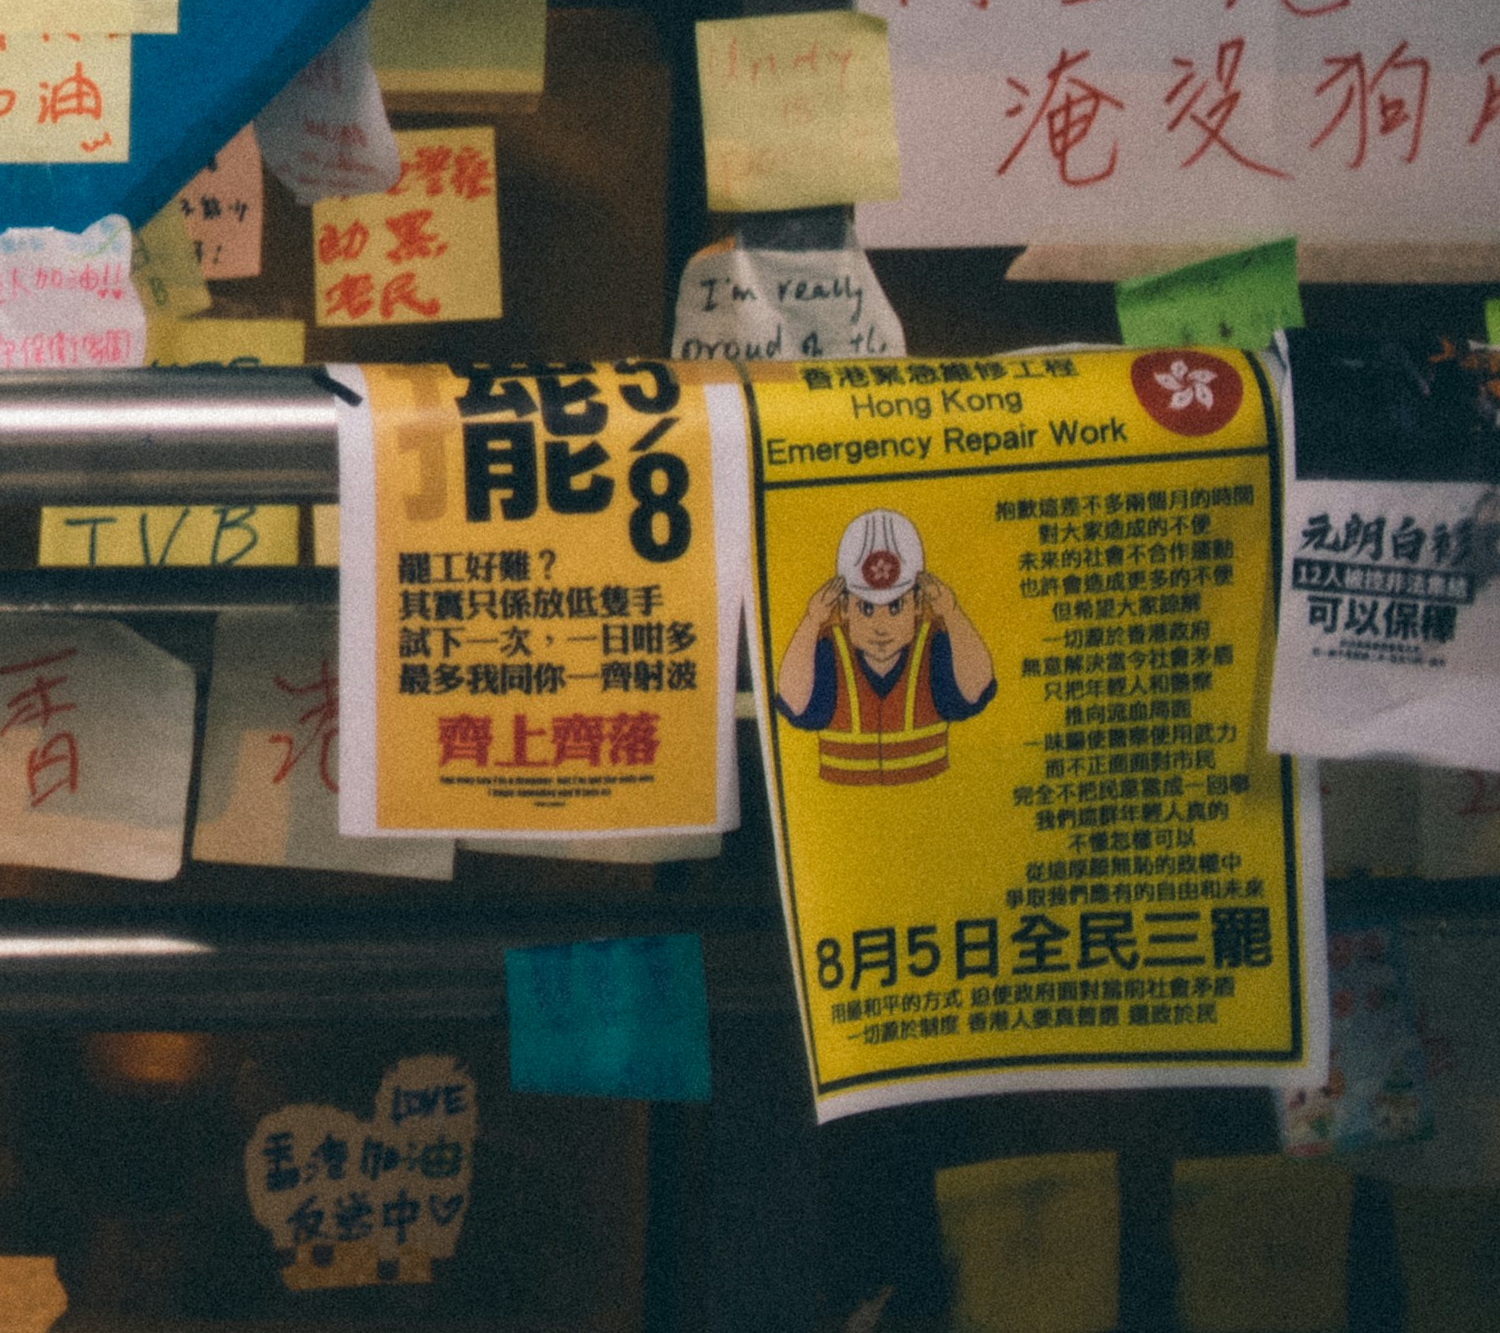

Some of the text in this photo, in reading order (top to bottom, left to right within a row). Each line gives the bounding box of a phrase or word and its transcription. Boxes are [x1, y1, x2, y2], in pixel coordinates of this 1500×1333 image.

[851, 385, 1025, 423] Hong Kong
[766, 417, 1129, 468] Emergency Repair Work
[438, 712, 662, 771] 齊上齊落
[814, 908, 1274, 992] 8月5日全民三罷
